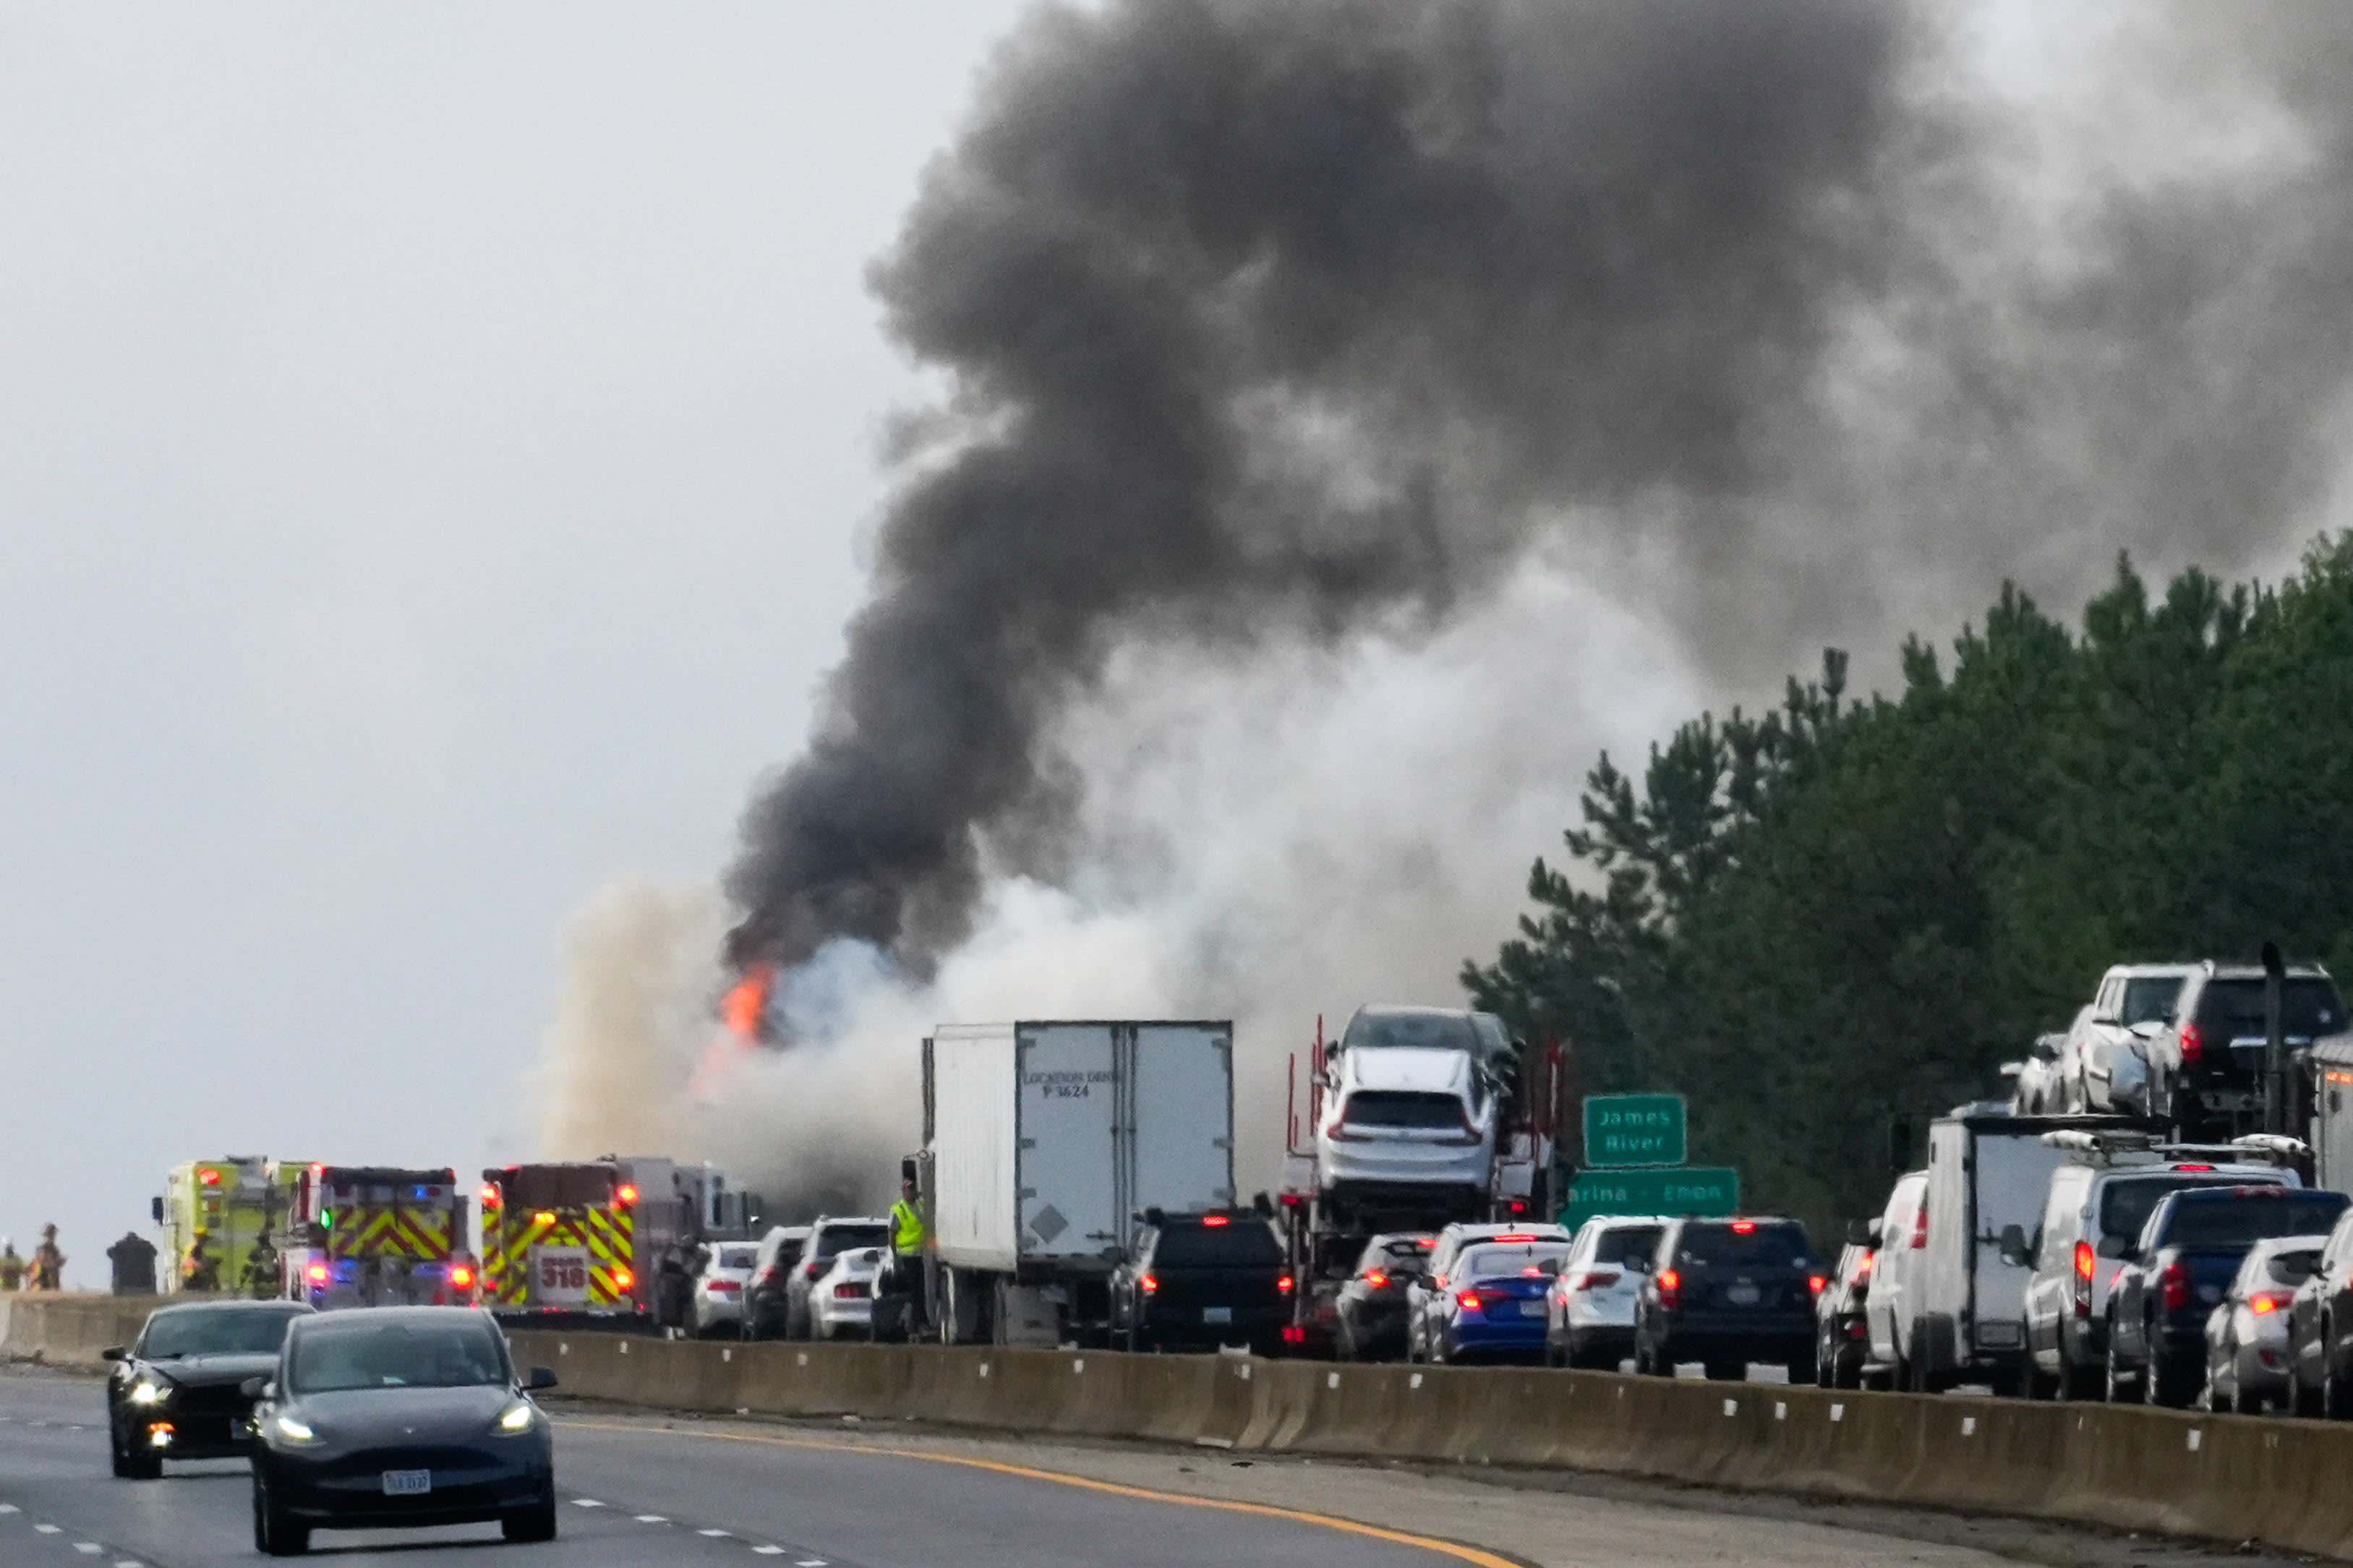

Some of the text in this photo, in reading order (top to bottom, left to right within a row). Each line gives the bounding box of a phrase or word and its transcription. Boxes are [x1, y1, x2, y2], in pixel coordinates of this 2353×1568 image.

[1600, 1110, 1670, 1126] James
[1605, 1134, 1663, 1151] River
[1567, 1185, 1626, 1203] arina
